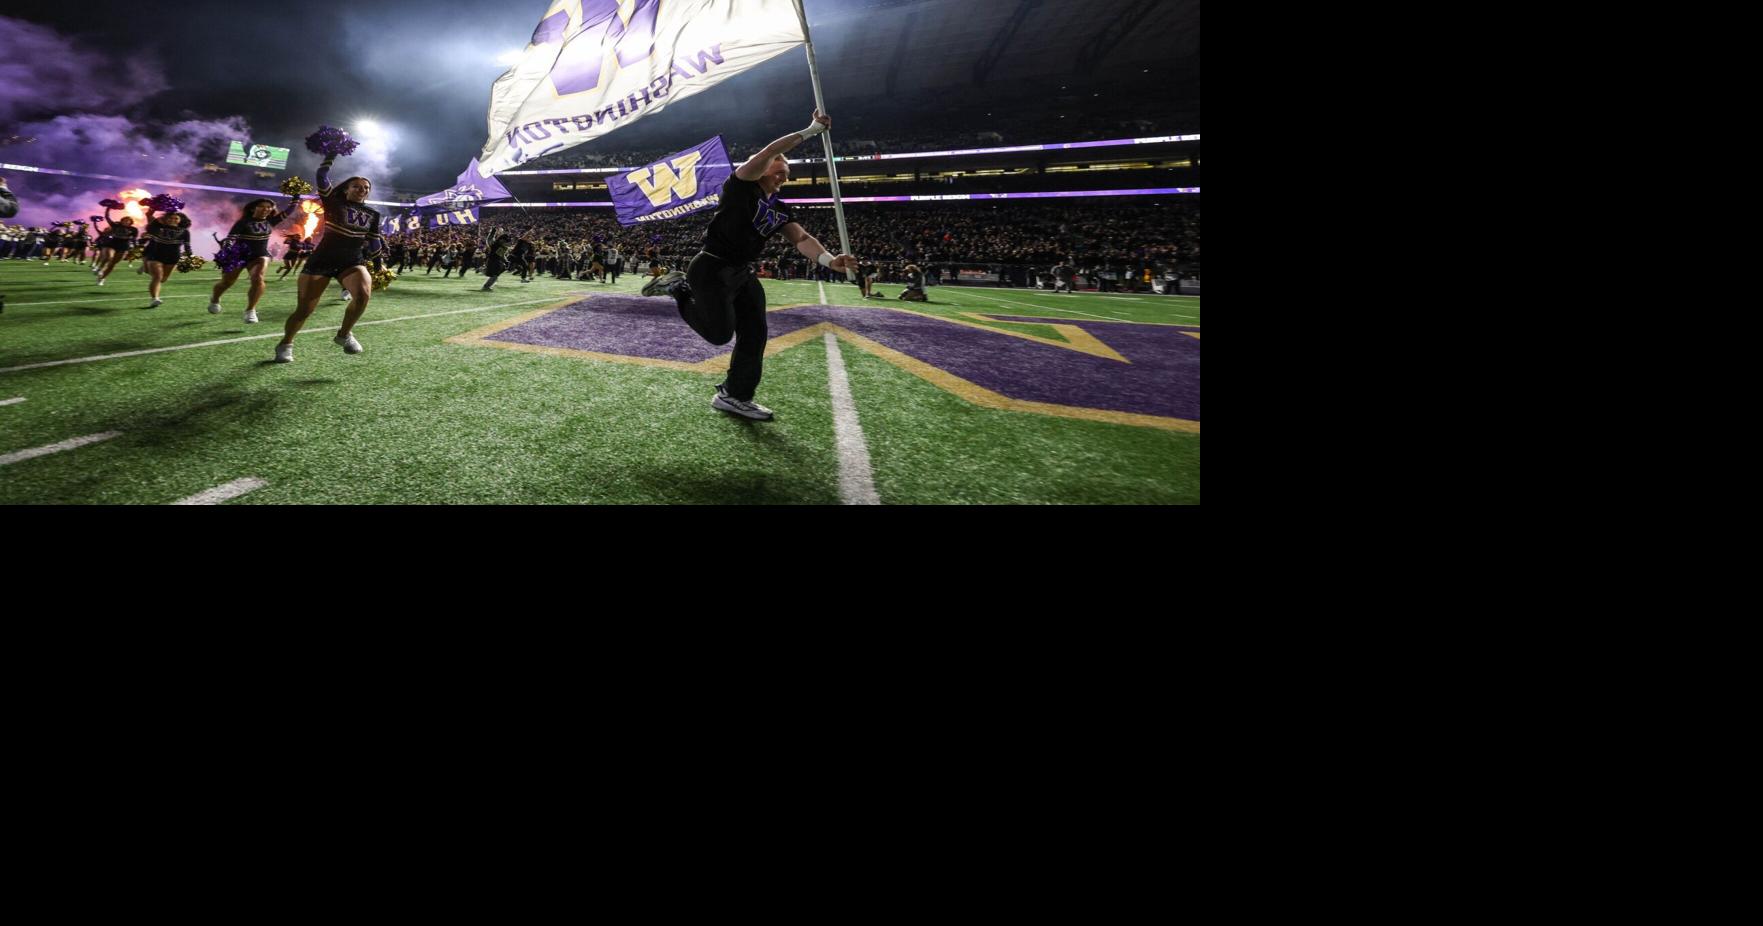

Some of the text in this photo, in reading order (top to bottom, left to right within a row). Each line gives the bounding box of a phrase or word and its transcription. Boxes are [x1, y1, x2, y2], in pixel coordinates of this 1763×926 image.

[250, 221, 269, 234] W
[347, 207, 371, 229] W
[752, 199, 789, 237] W
